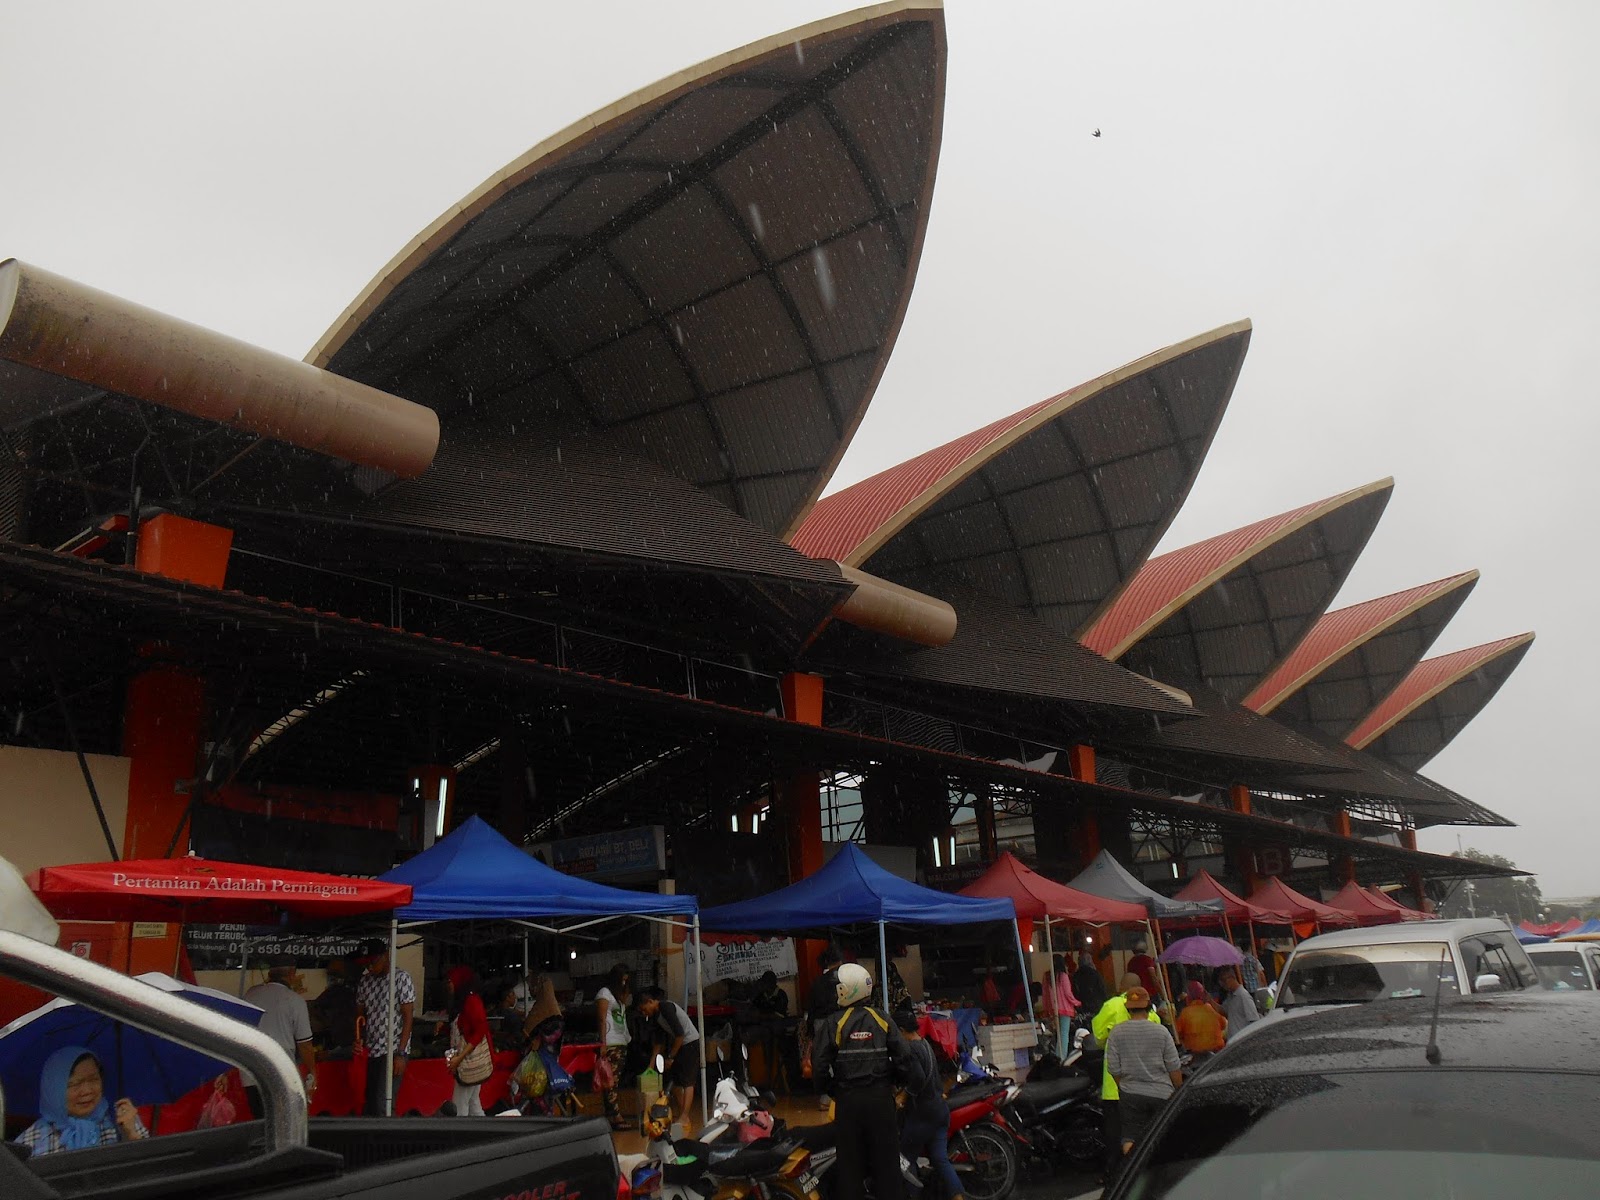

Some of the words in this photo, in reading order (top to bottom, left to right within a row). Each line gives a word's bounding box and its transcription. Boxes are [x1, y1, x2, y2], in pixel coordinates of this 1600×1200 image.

[112, 873, 201, 890] Pertanian
[205, 877, 266, 893] Adalah
[270, 879, 359, 897] Perniagaan
[219, 923, 246, 931] PENJU
